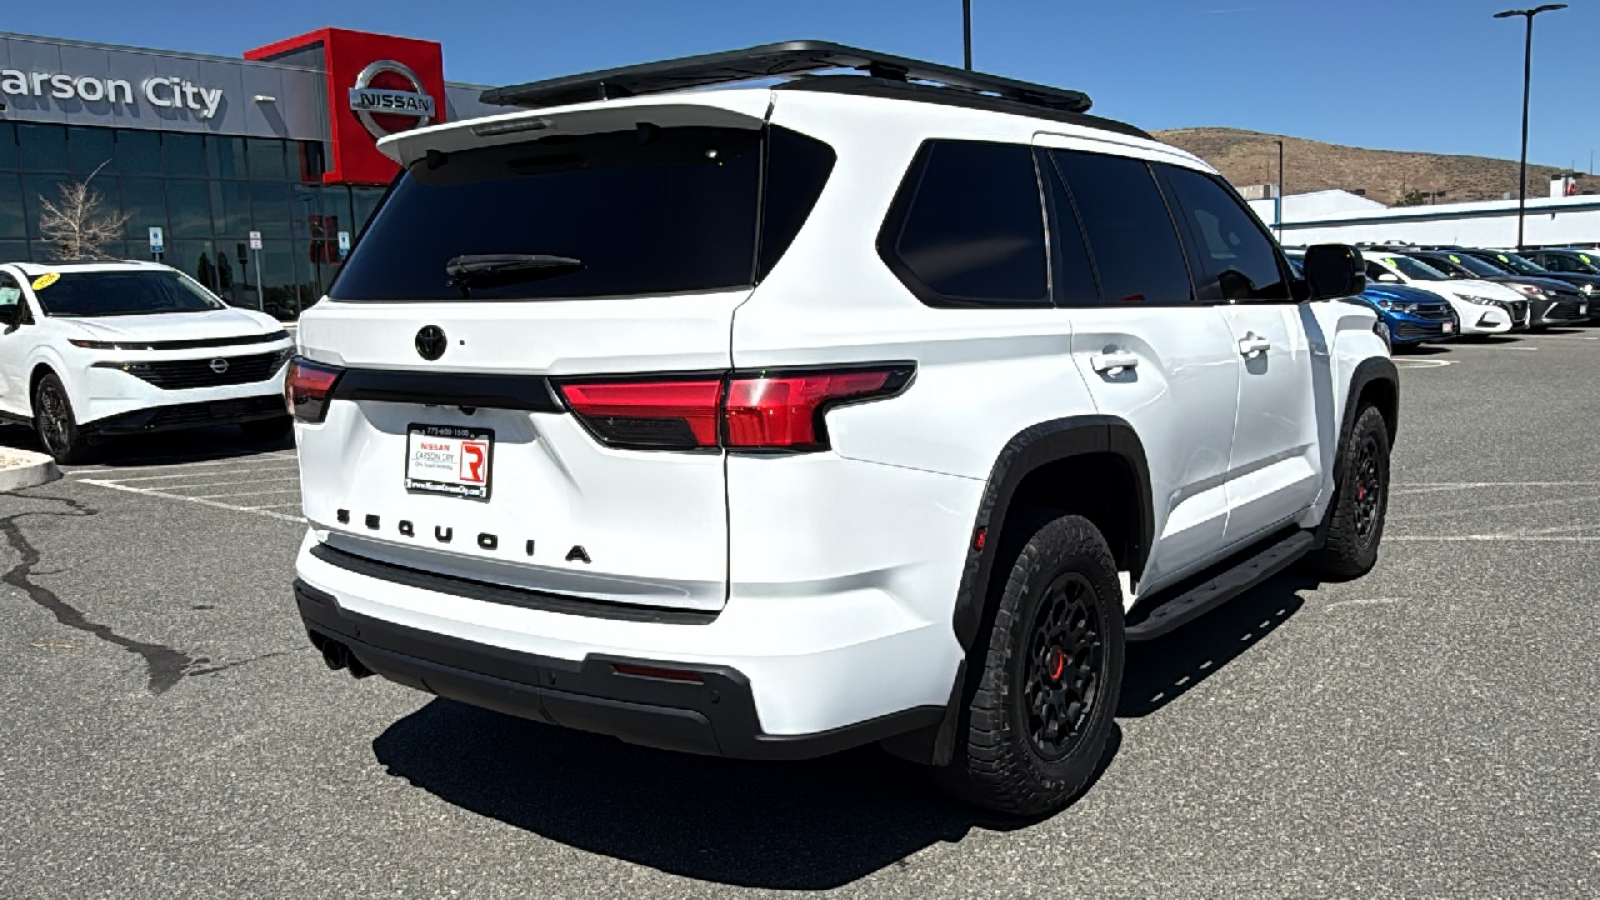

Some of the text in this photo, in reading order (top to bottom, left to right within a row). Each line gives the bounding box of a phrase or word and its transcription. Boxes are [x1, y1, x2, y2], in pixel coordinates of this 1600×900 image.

[0, 69, 223, 118] arson City
[360, 93, 430, 111] NISSAN
[420, 442, 450, 451] NISSAN
[337, 508, 592, 564] SEQUOIA
